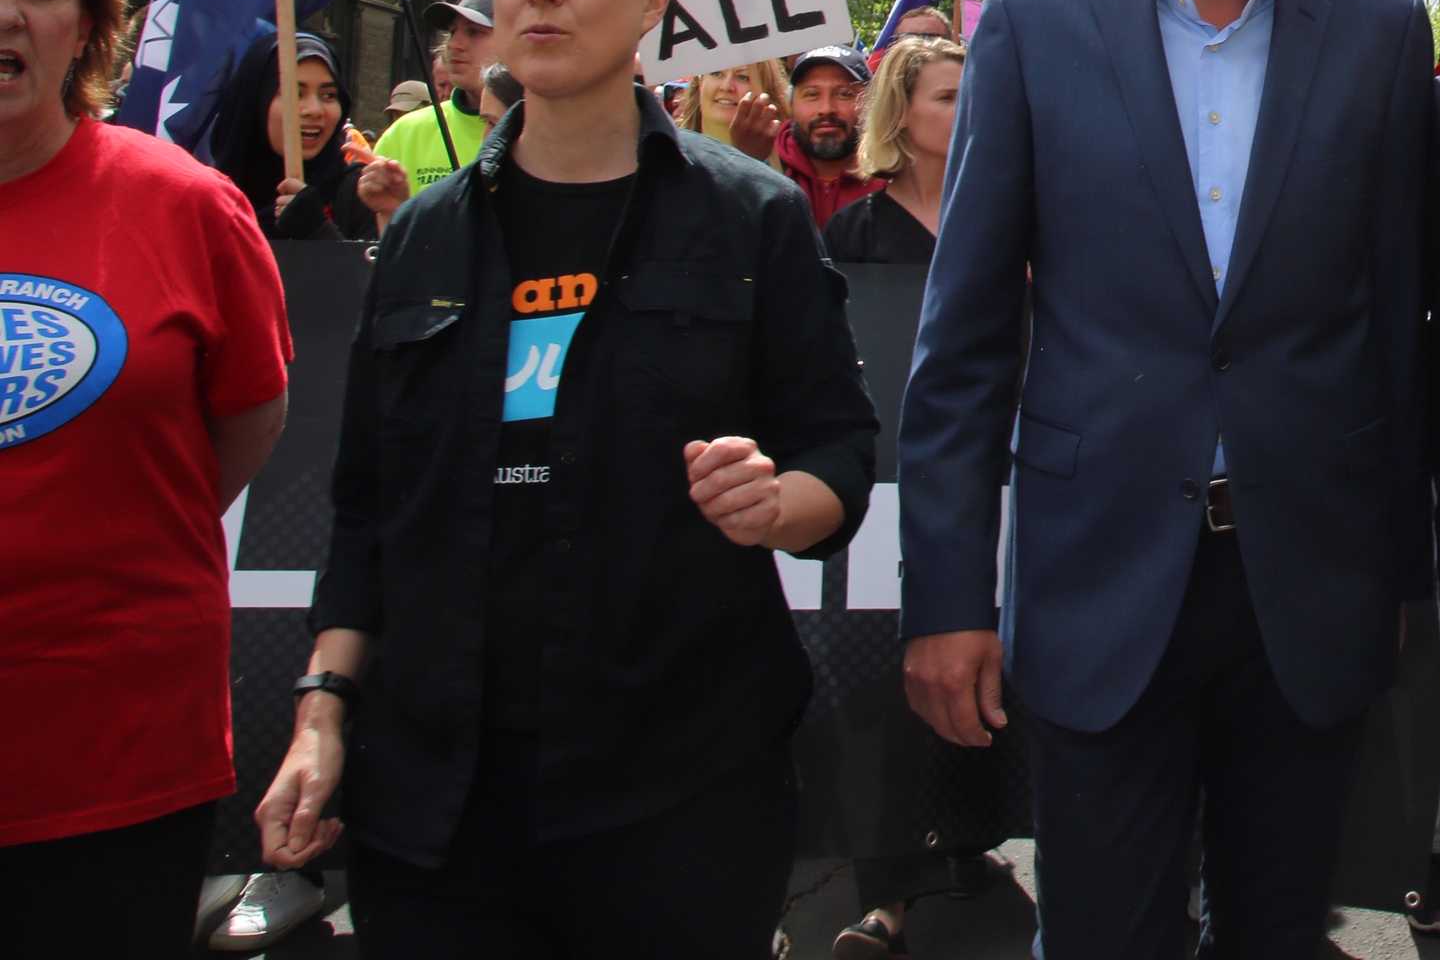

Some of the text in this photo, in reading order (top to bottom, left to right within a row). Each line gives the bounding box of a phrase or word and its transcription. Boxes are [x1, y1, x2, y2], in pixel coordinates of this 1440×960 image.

[0, 279, 90, 310] RANCH
[0, 308, 70, 340] ES
[0, 368, 67, 414] RS
[494, 464, 551, 484] ustra
